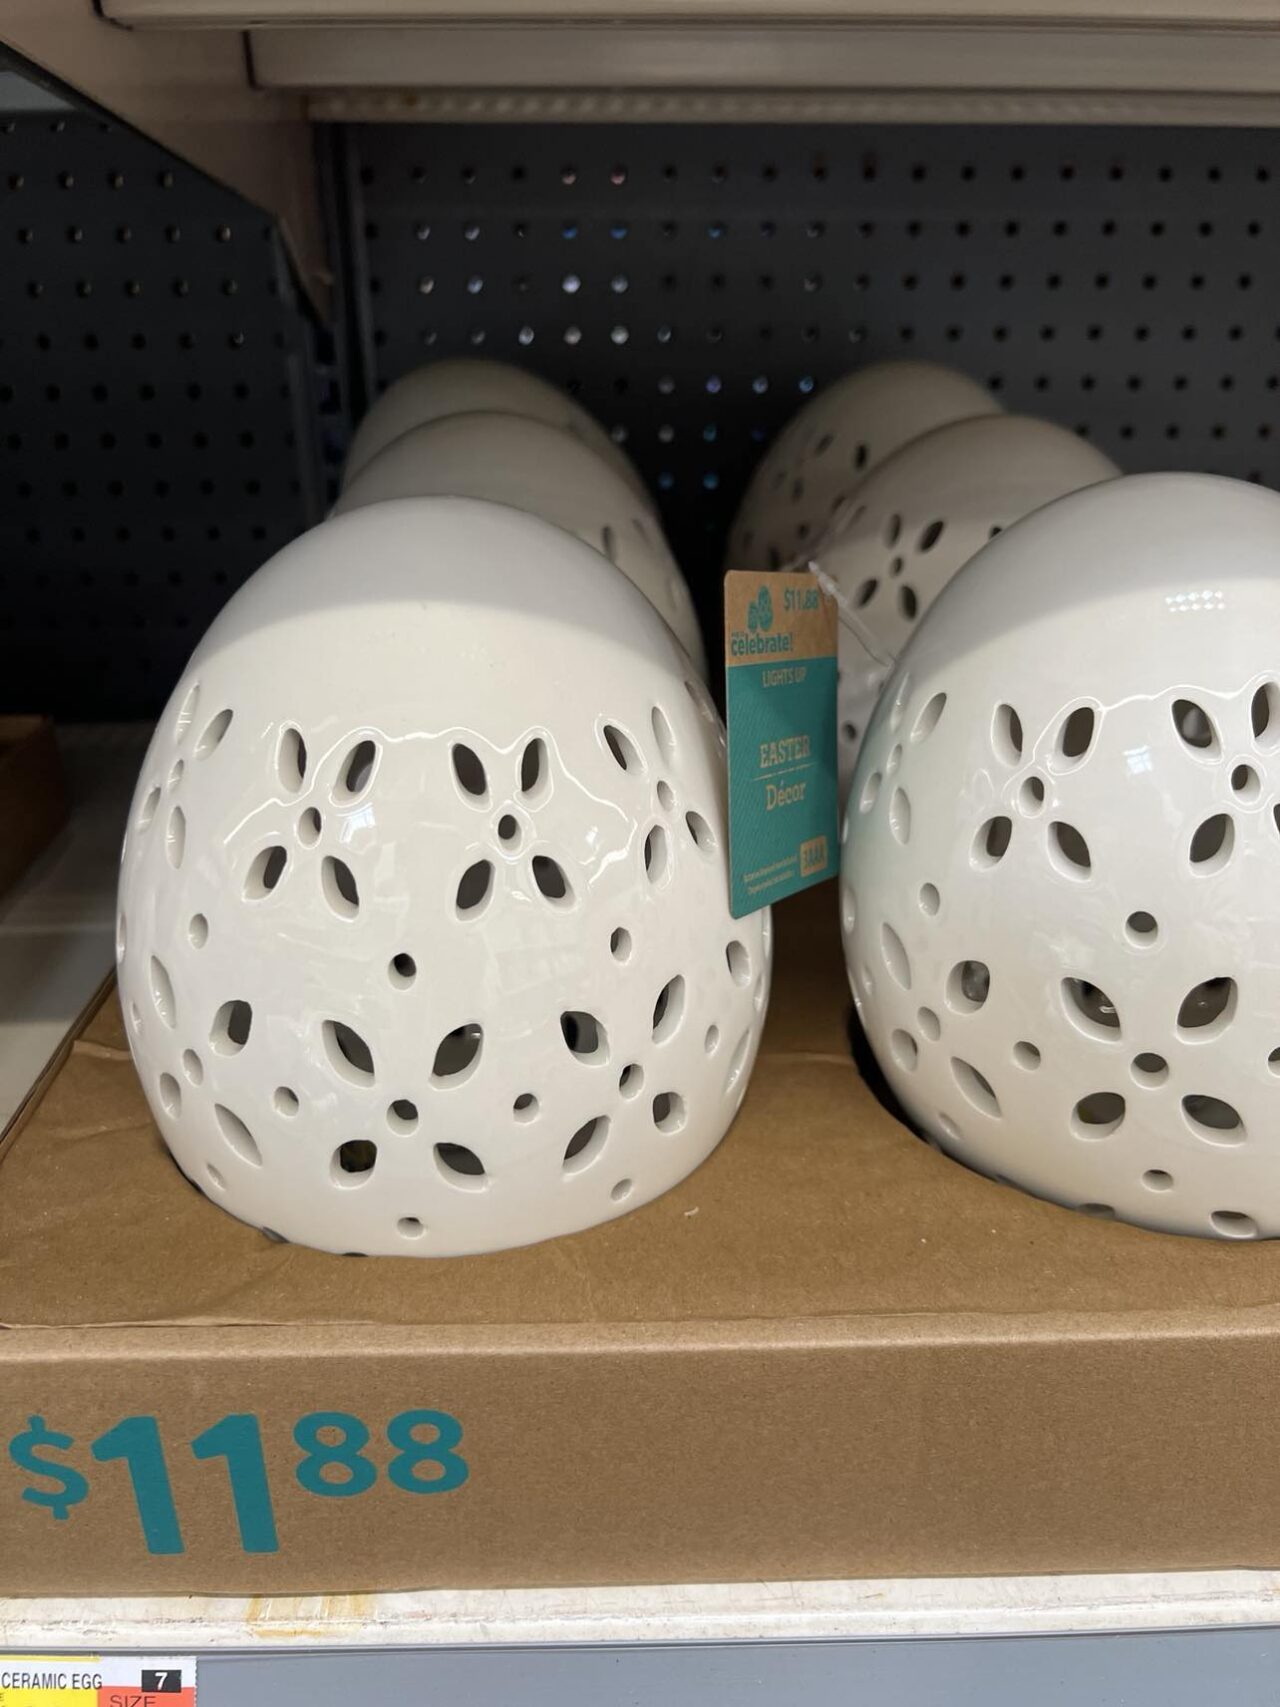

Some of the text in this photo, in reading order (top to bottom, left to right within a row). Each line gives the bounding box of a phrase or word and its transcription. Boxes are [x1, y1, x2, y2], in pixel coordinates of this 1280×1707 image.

[762, 667, 807, 688] LIGHTS UP
[759, 735, 811, 769] EASTER
[766, 779, 807, 811] Décor
[1, 1671, 103, 1690] CERAMIC EGG
[154, 1672, 168, 1690] 7
